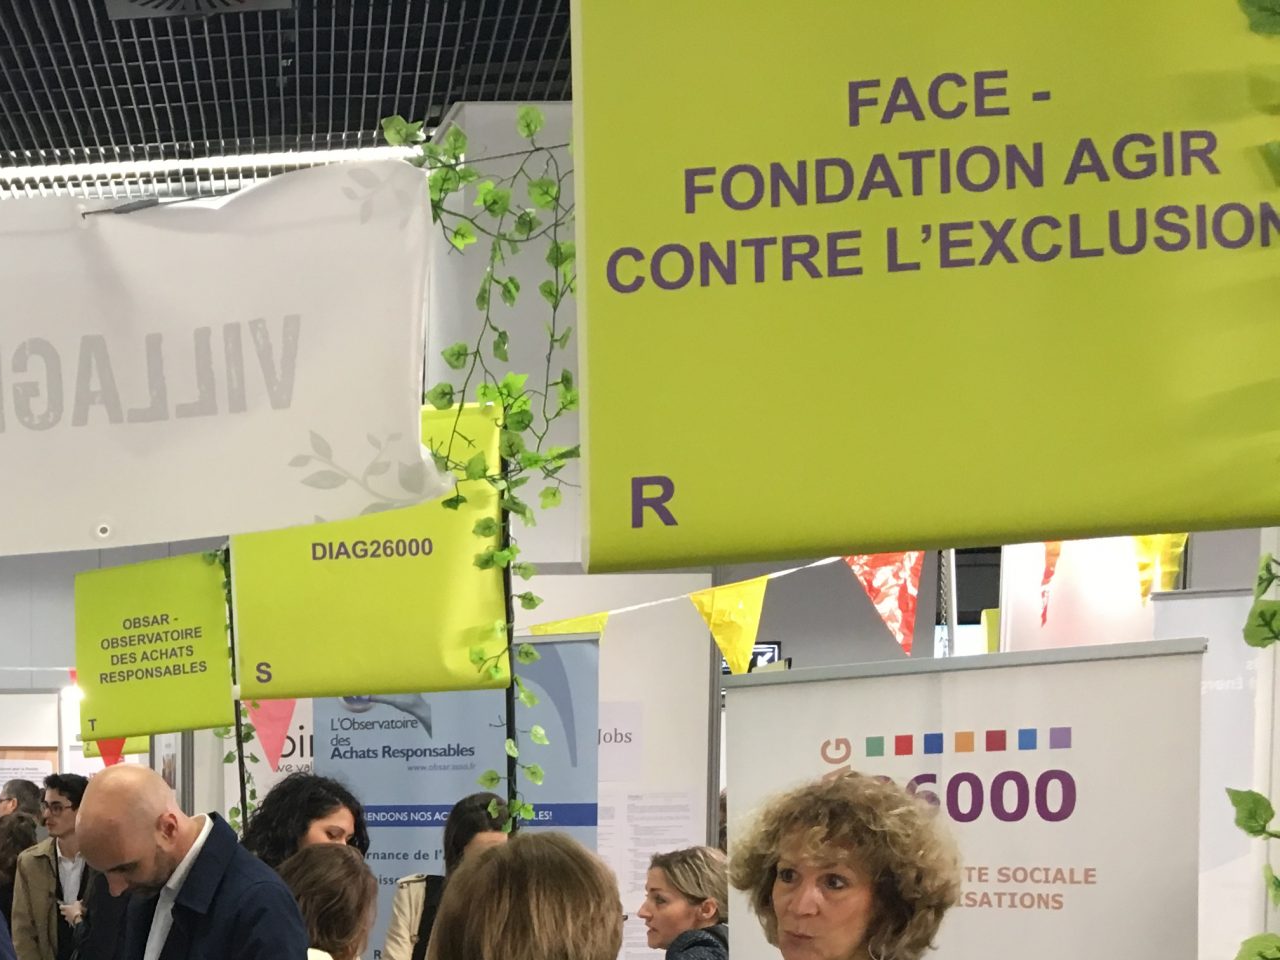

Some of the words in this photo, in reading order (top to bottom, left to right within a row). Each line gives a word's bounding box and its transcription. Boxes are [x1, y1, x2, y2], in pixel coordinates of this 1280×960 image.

[848, 70, 1010, 127] FACE
[1032, 90, 1051, 102] -
[684, 142, 1044, 214] FONDATION
[1063, 130, 1220, 185] AGIR
[606, 229, 863, 293] CONTRE
[630, 476, 679, 529] R
[311, 538, 434, 561] DIAG26000
[122, 614, 170, 630] OBSAR
[100, 626, 203, 650] OBSERVATOIRE
[111, 652, 137, 666] DES
[140, 645, 194, 663] ACHATS
[99, 661, 208, 684] RESPONSABLES
[255, 664, 273, 684] S
[88, 719, 97, 731] T
[330, 717, 418, 731] L'Observatoire
[331, 734, 351, 746] des
[597, 728, 632, 745] Jobs
[330, 746, 378, 760] Achats
[382, 743, 475, 761] Responsables
[874, 769, 1077, 823] 6000
[411, 811, 432, 820] NOS
[434, 811, 449, 820] AC
[366, 851, 409, 860] rnance
[414, 850, 430, 860] de
[965, 867, 989, 883] TE
[997, 867, 1097, 885] SOCIALE
[955, 892, 1064, 910] ISATIONS
